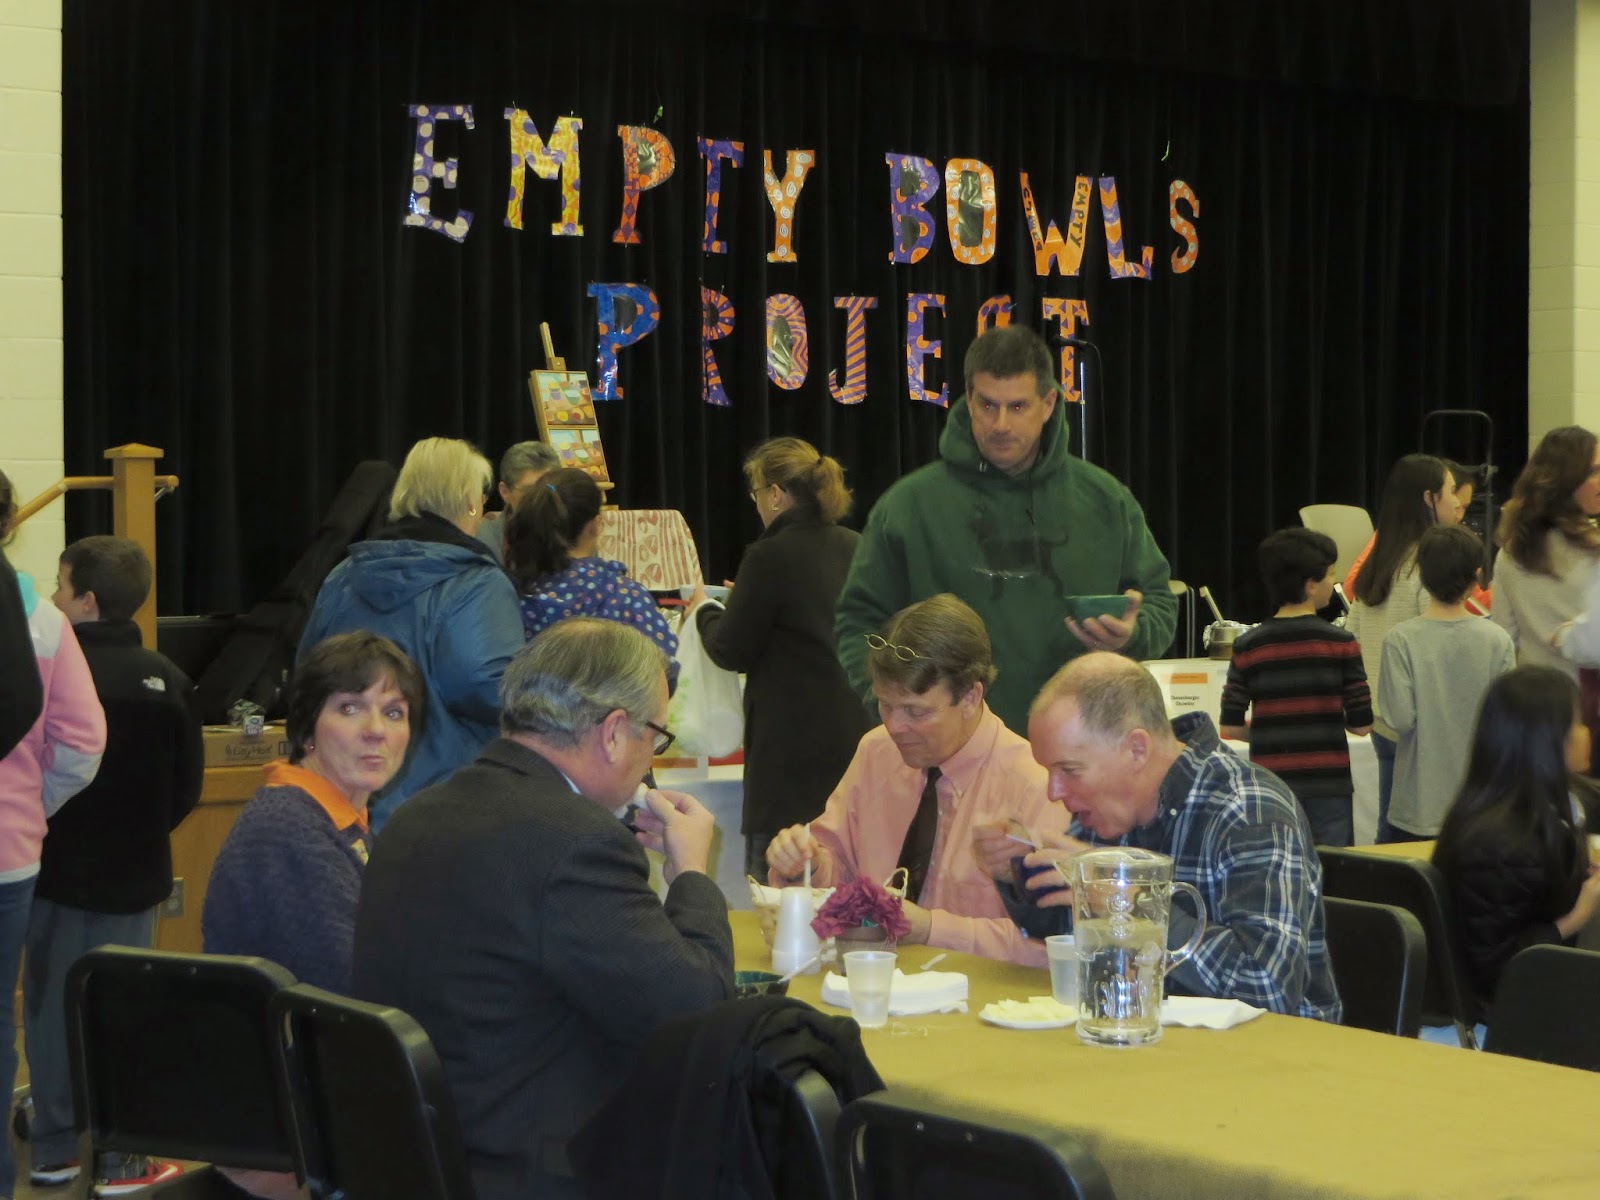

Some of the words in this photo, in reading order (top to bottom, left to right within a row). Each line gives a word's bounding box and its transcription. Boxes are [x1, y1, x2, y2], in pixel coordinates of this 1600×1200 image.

[403, 105, 815, 262] EMPTY
[885, 152, 1200, 280] BOWLS
[1070, 181, 1087, 247] EMPTY
